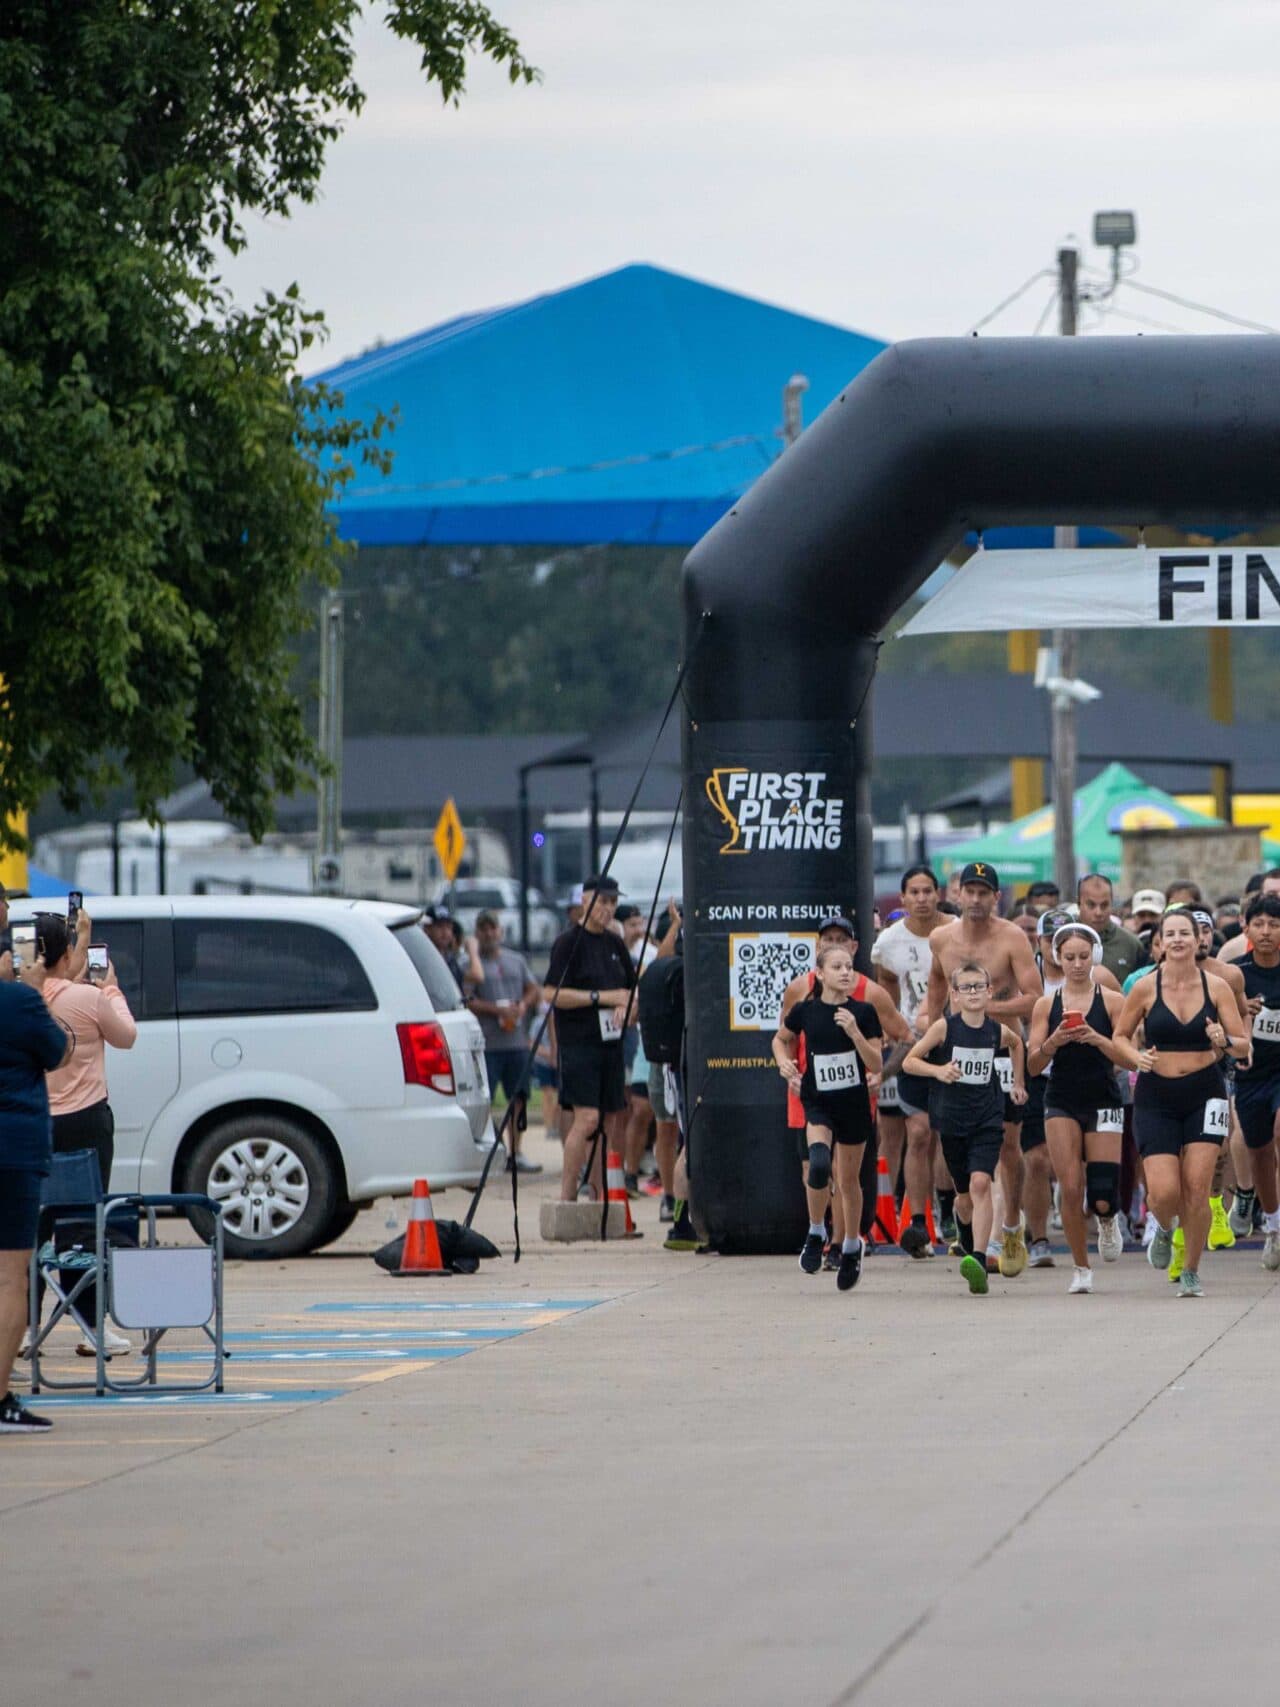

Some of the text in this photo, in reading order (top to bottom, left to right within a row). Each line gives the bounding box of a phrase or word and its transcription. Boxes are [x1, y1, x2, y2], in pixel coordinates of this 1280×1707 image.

[727, 772, 826, 800] FIRST
[738, 799, 844, 826] PLACE
[741, 825, 842, 850] TIMING
[708, 905, 842, 920] SCAN FOR RESULTS
[819, 1064, 855, 1083] 1093
